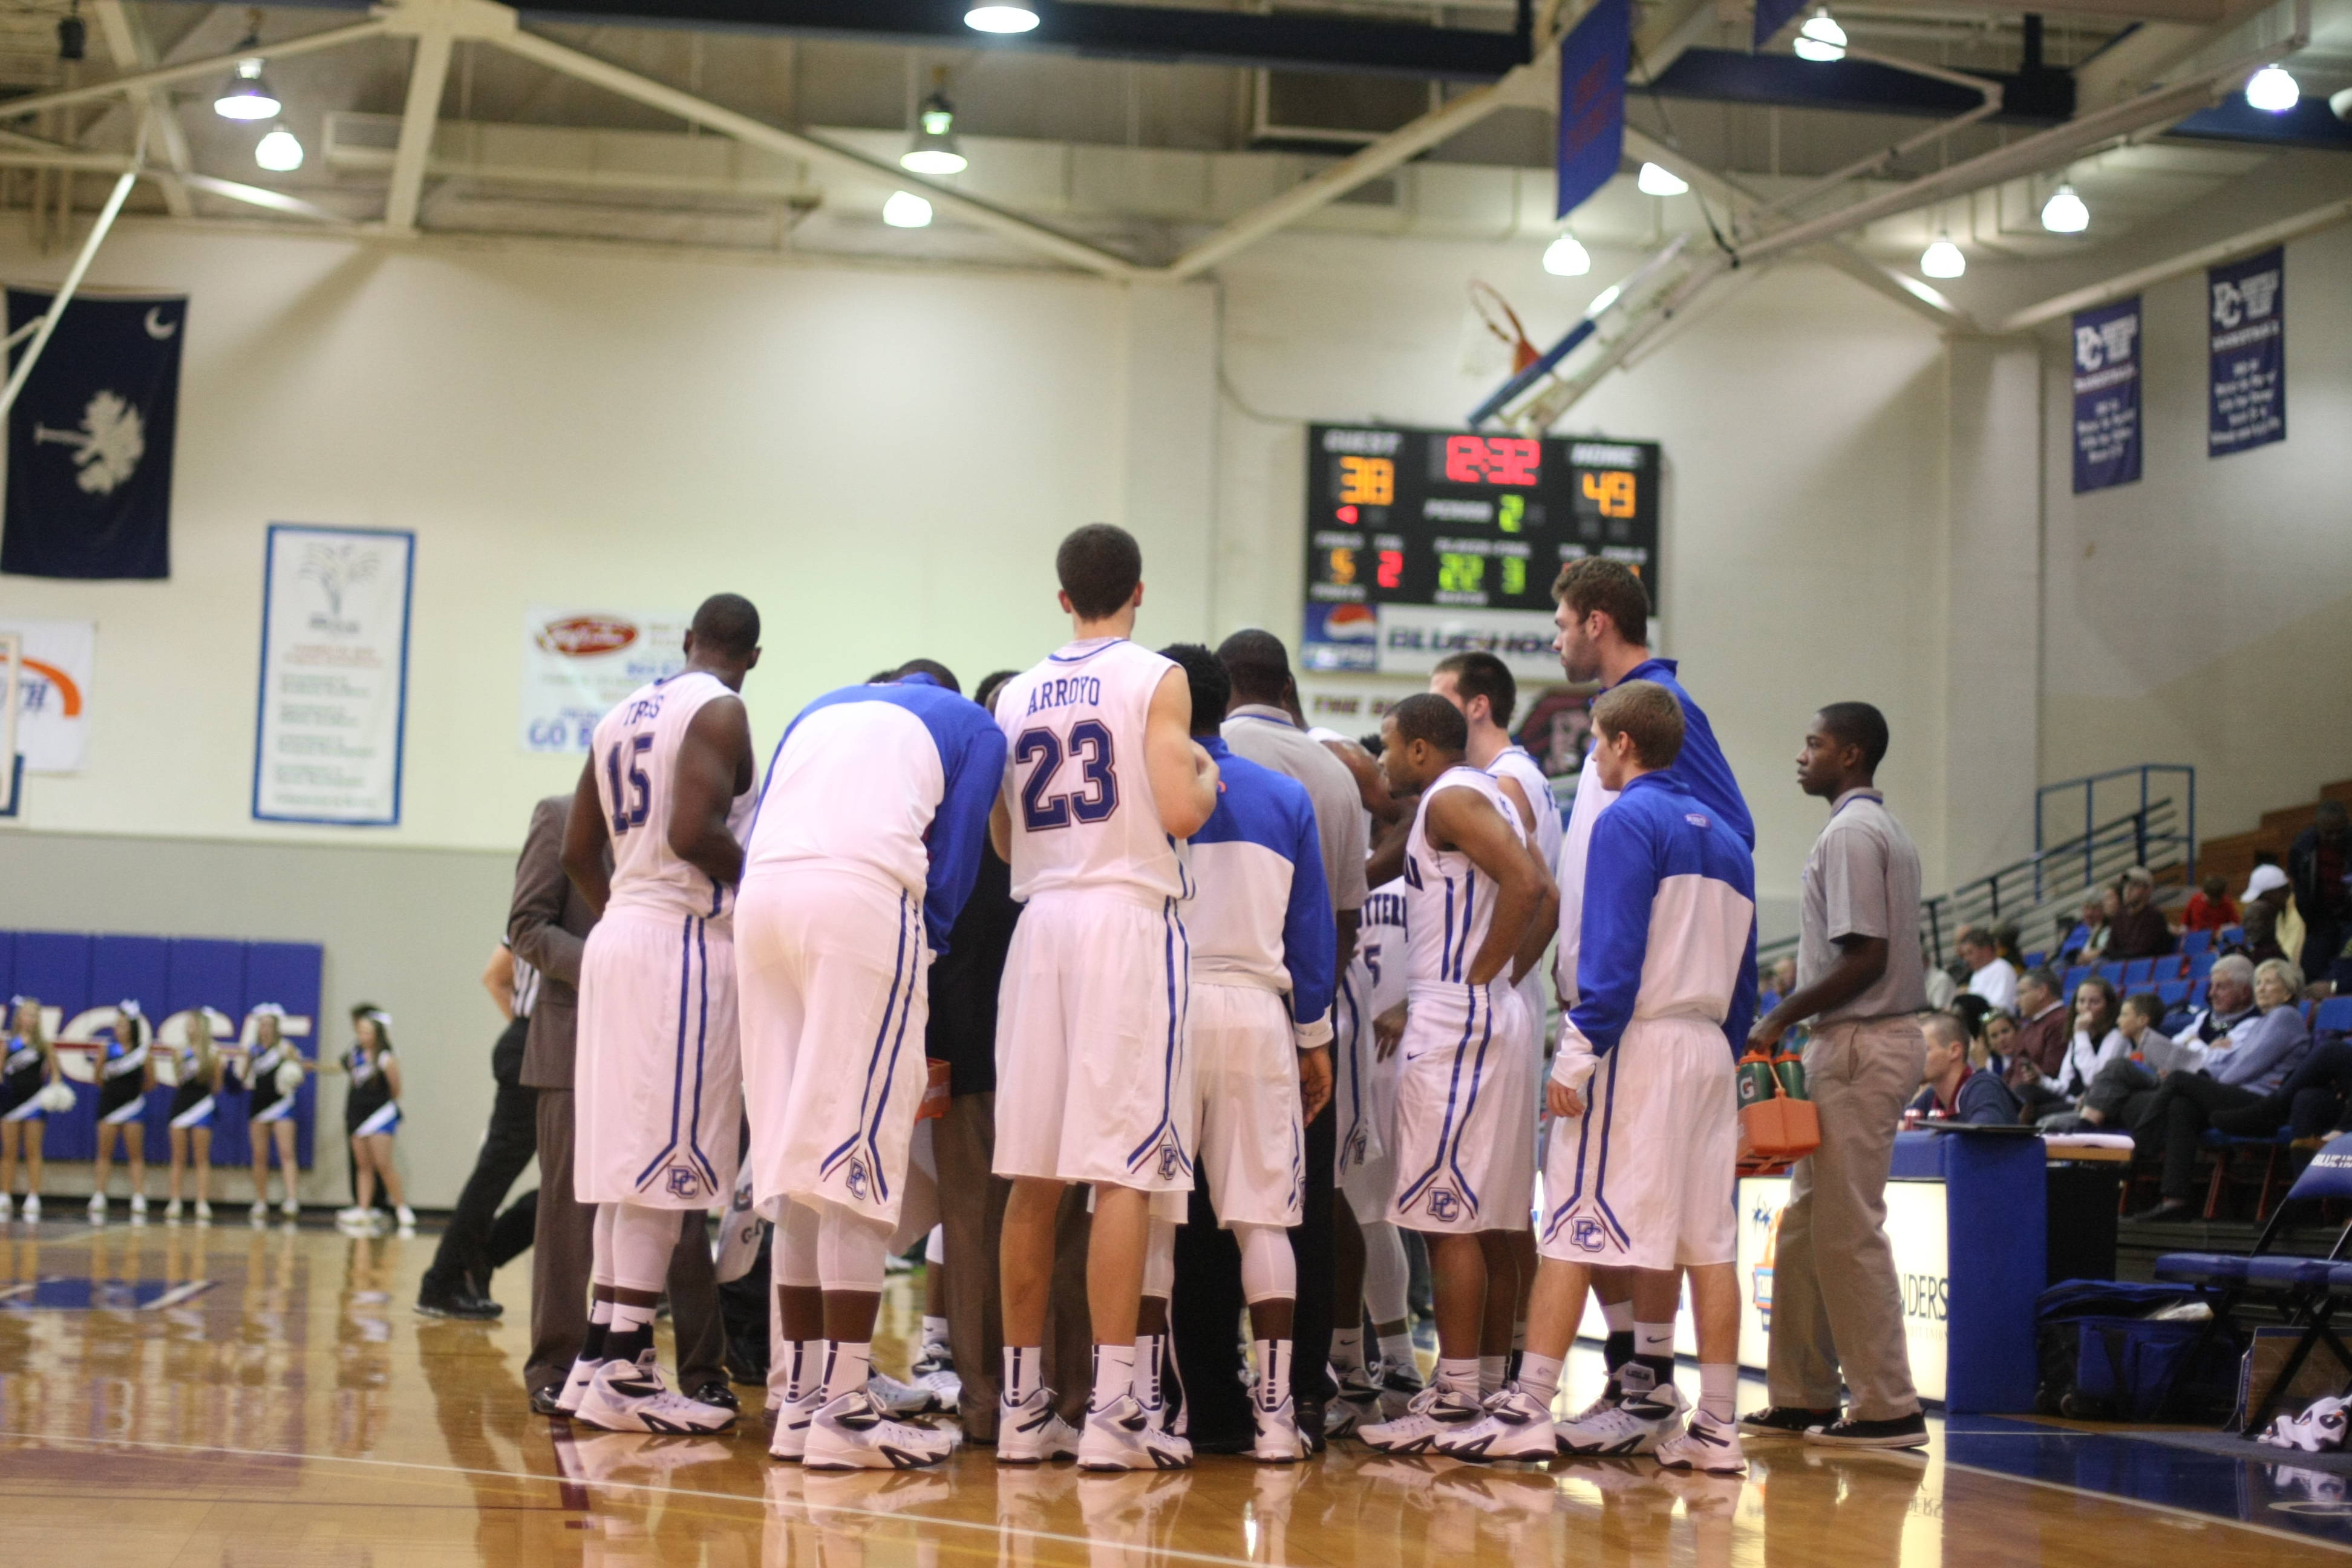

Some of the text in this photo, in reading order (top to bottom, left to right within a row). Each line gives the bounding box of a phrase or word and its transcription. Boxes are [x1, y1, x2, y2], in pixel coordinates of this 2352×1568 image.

[1339, 456, 1394, 506] 38
[1582, 470, 1636, 519] 49
[1498, 493, 1525, 534] 2
[1377, 549, 1403, 588] 2
[1026, 675, 1101, 717] ARROYO
[607, 732, 656, 836] 15
[1014, 719, 1119, 833] 23
[670, 1168, 697, 1197] PC
[1430, 1190, 1458, 1219] PC
[1574, 1220, 1602, 1249] PC
